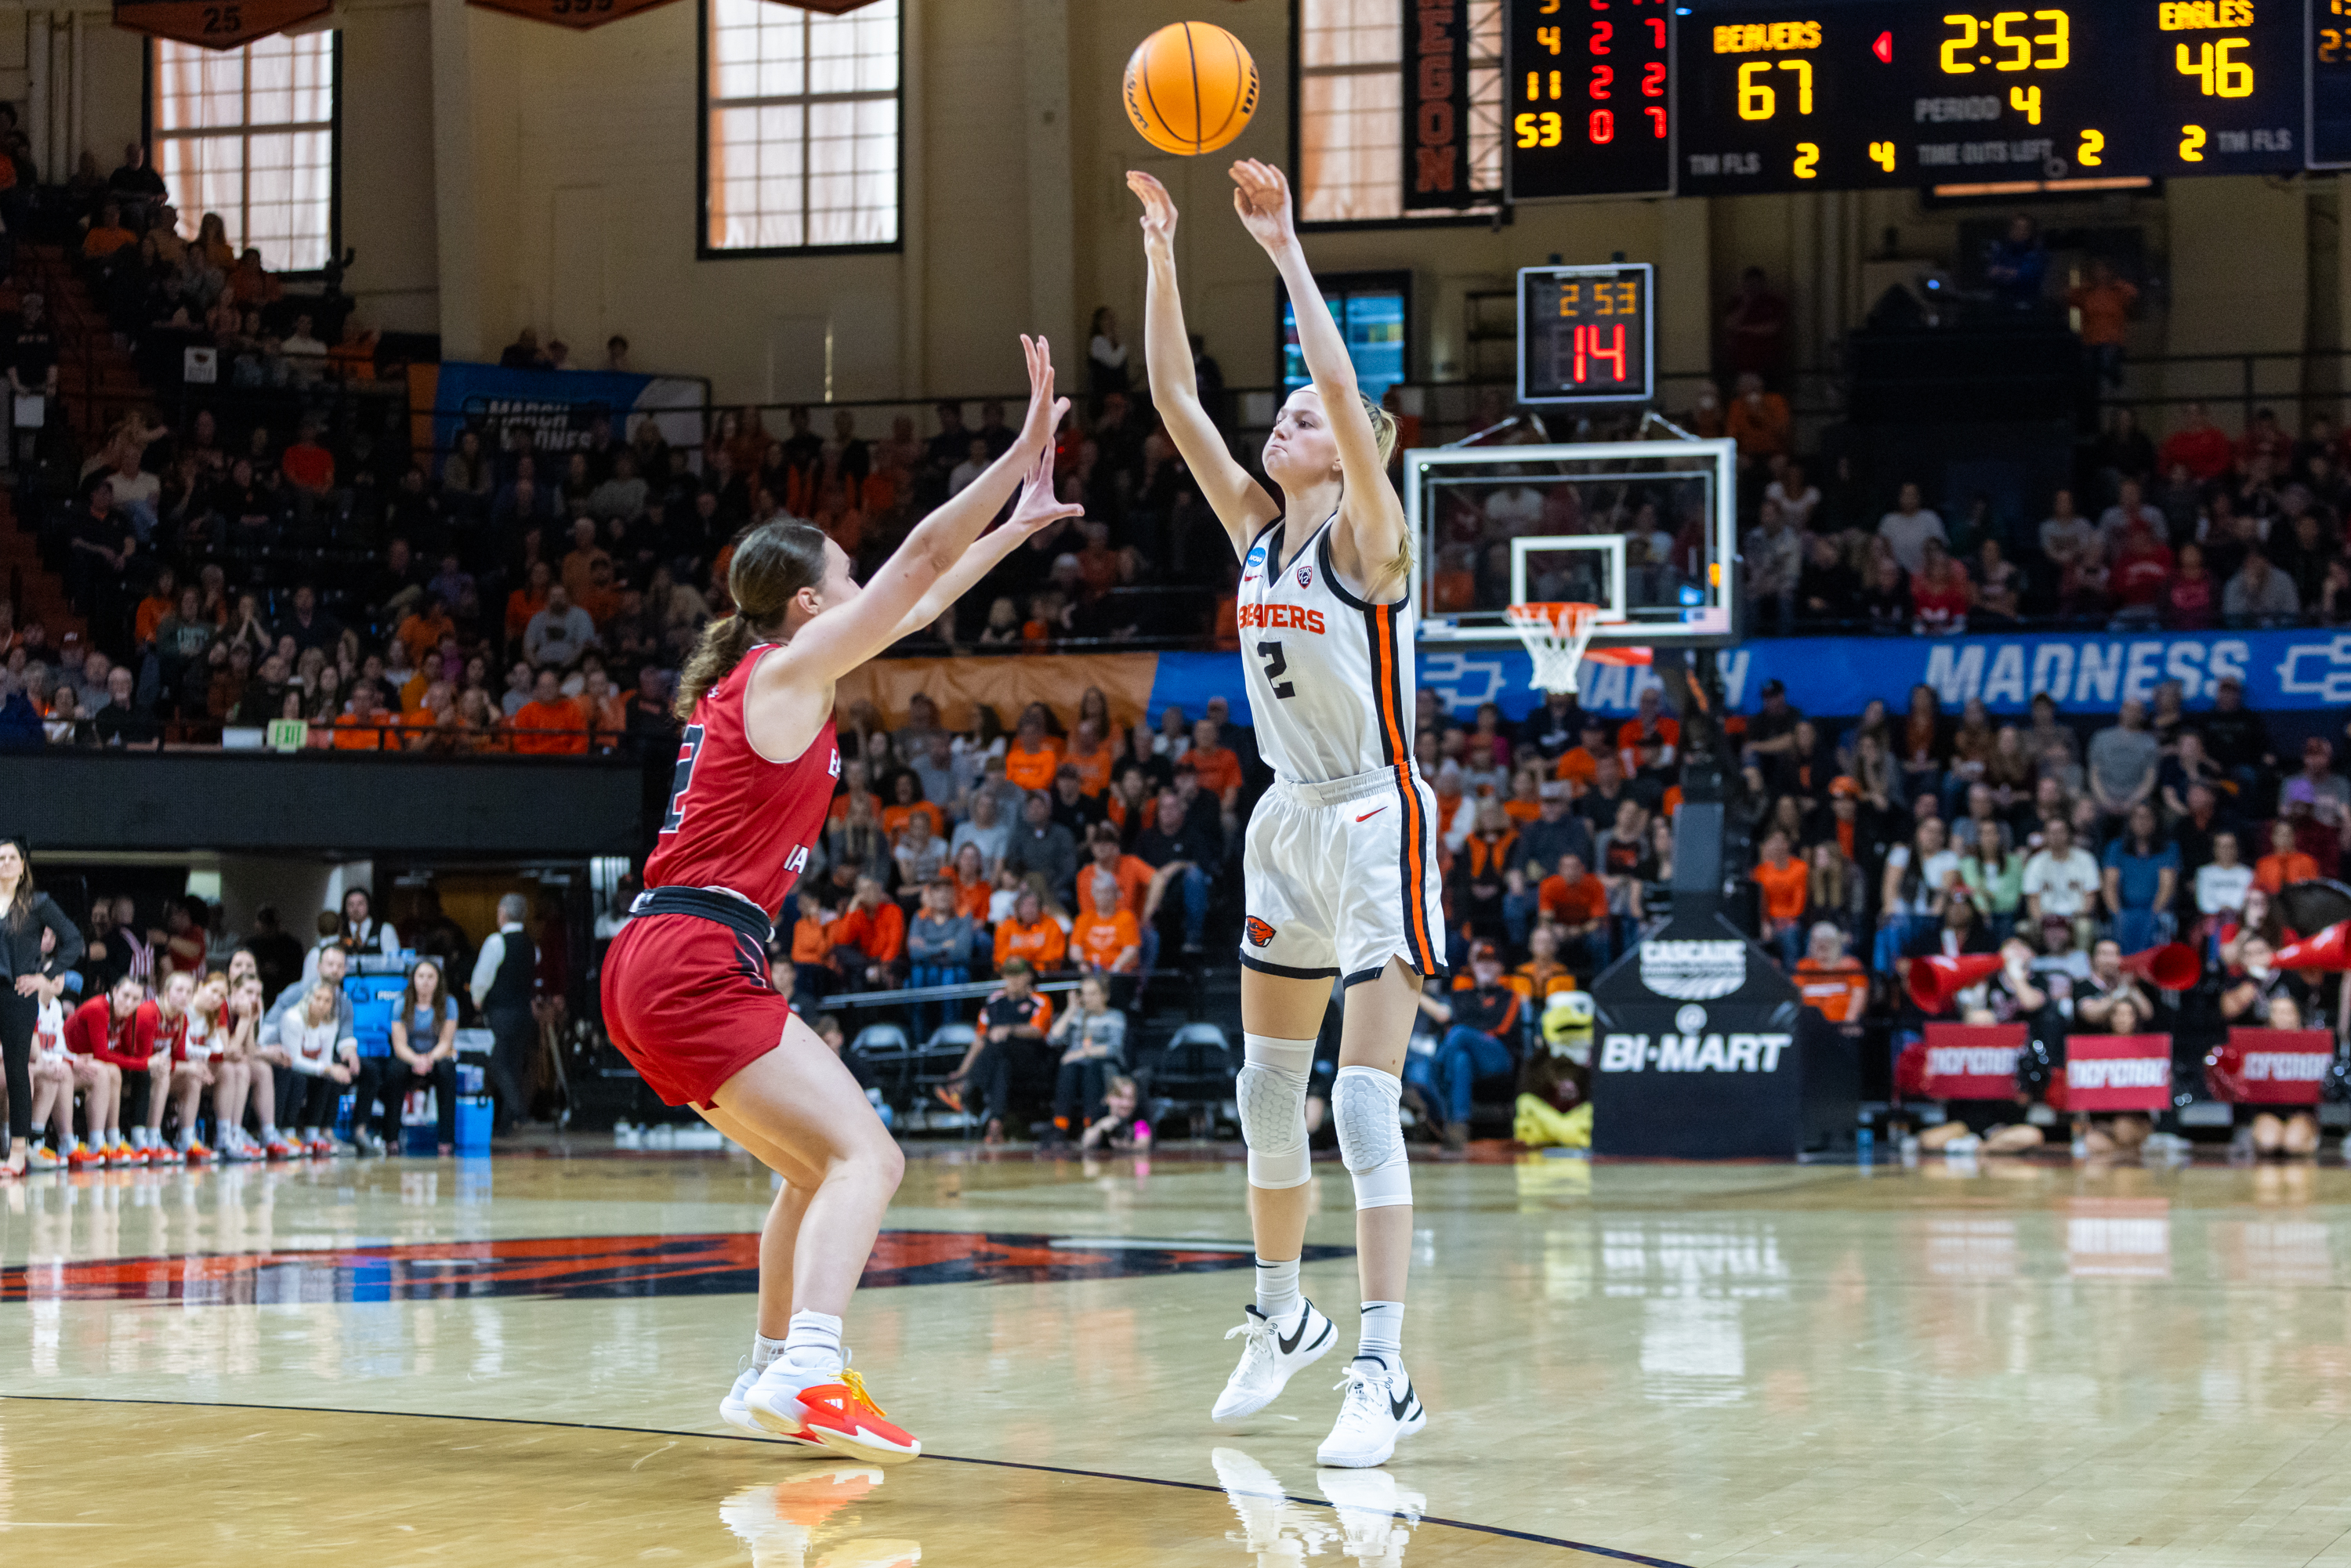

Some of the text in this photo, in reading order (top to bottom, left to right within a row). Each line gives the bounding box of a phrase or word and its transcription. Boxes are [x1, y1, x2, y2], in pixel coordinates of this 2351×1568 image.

[201, 5, 241, 34] 25
[1537, 17, 1666, 56] 4 2 7
[1940, 9, 2069, 74] 2:53
[1527, 62, 1666, 101] 11 2 2
[2176, 38, 2254, 98] 46
[1415, 0, 1455, 193] EGON
[1738, 60, 1813, 121] 67
[2010, 85, 2041, 125] 4
[1514, 106, 1667, 148] 53 0 7
[2179, 125, 2206, 162] 2
[1794, 143, 1820, 179] 2
[1869, 141, 1895, 172] 4
[2078, 129, 2104, 166] 2
[1559, 282, 1636, 317] 2 53
[1574, 324, 1626, 383] 14
[1248, 554, 1262, 563] NCAA
[1298, 567, 1311, 579] PAC
[1300, 576, 1309, 585] 12
[1257, 641, 1295, 699] 2
[1925, 639, 2250, 704] MADNESS
